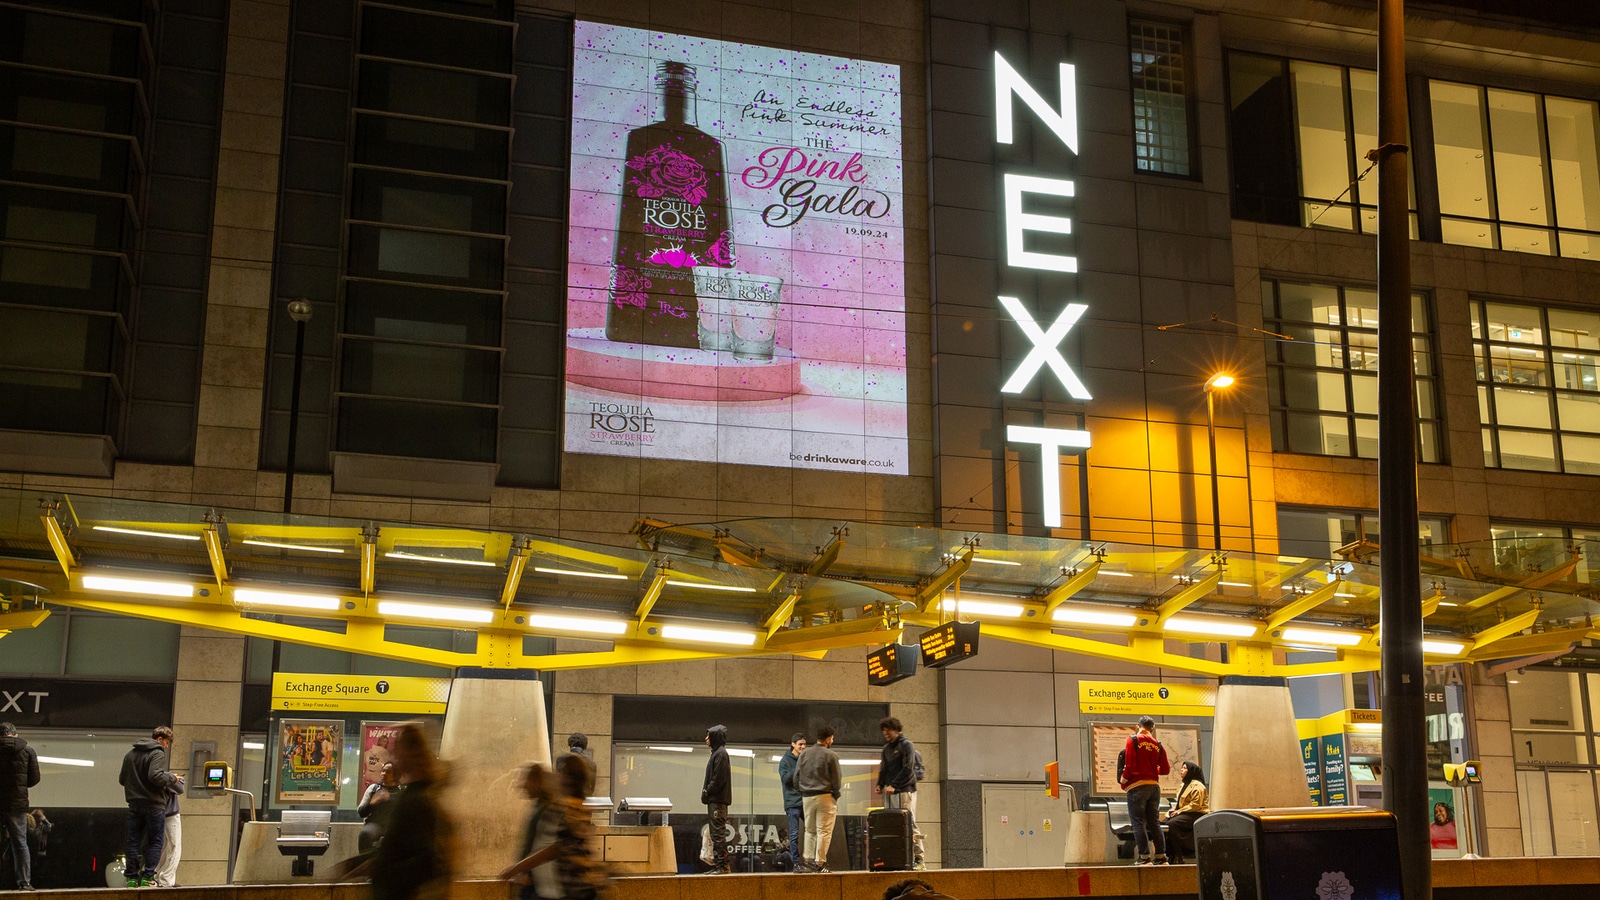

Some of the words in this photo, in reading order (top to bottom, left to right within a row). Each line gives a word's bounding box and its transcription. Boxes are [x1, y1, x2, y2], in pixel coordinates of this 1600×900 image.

[753, 89, 784, 105] An
[796, 97, 878, 118] Endless
[742, 104, 792, 122] Pink
[801, 113, 890, 135] Summer
[804, 137, 834, 149] THE
[742, 147, 868, 189] Pink
[643, 198, 705, 216] TEQUILA
[762, 178, 890, 228] Gala
[643, 208, 707, 230] ROSE
[643, 225, 706, 238] STRAWBERRY
[845, 227, 888, 238] 19.09.24
[706, 283, 728, 293] ROS
[995, 50, 1093, 528] NEXT
[589, 402, 654, 417] TEQUILA
[590, 412, 656, 433] ROSE
[590, 430, 654, 442] STRAWBERRY
[790, 452, 802, 462] be
[803, 454, 894, 468] drinkaware.co.uk
[285, 682, 333, 695] Exchange
[336, 683, 370, 695] Square
[1088, 688, 1126, 700] Exchange
[1128, 690, 1154, 700] Square
[1352, 712, 1376, 721] Tickets
[369, 730, 398, 738] WHITE
[1525, 740, 1534, 757] 1
[291, 772, 312, 780] Let's
[314, 771, 328, 779] Go!
[1326, 764, 1343, 774] family?
[1307, 774, 1319, 783] kets?
[727, 845, 762, 854] OFFEE
